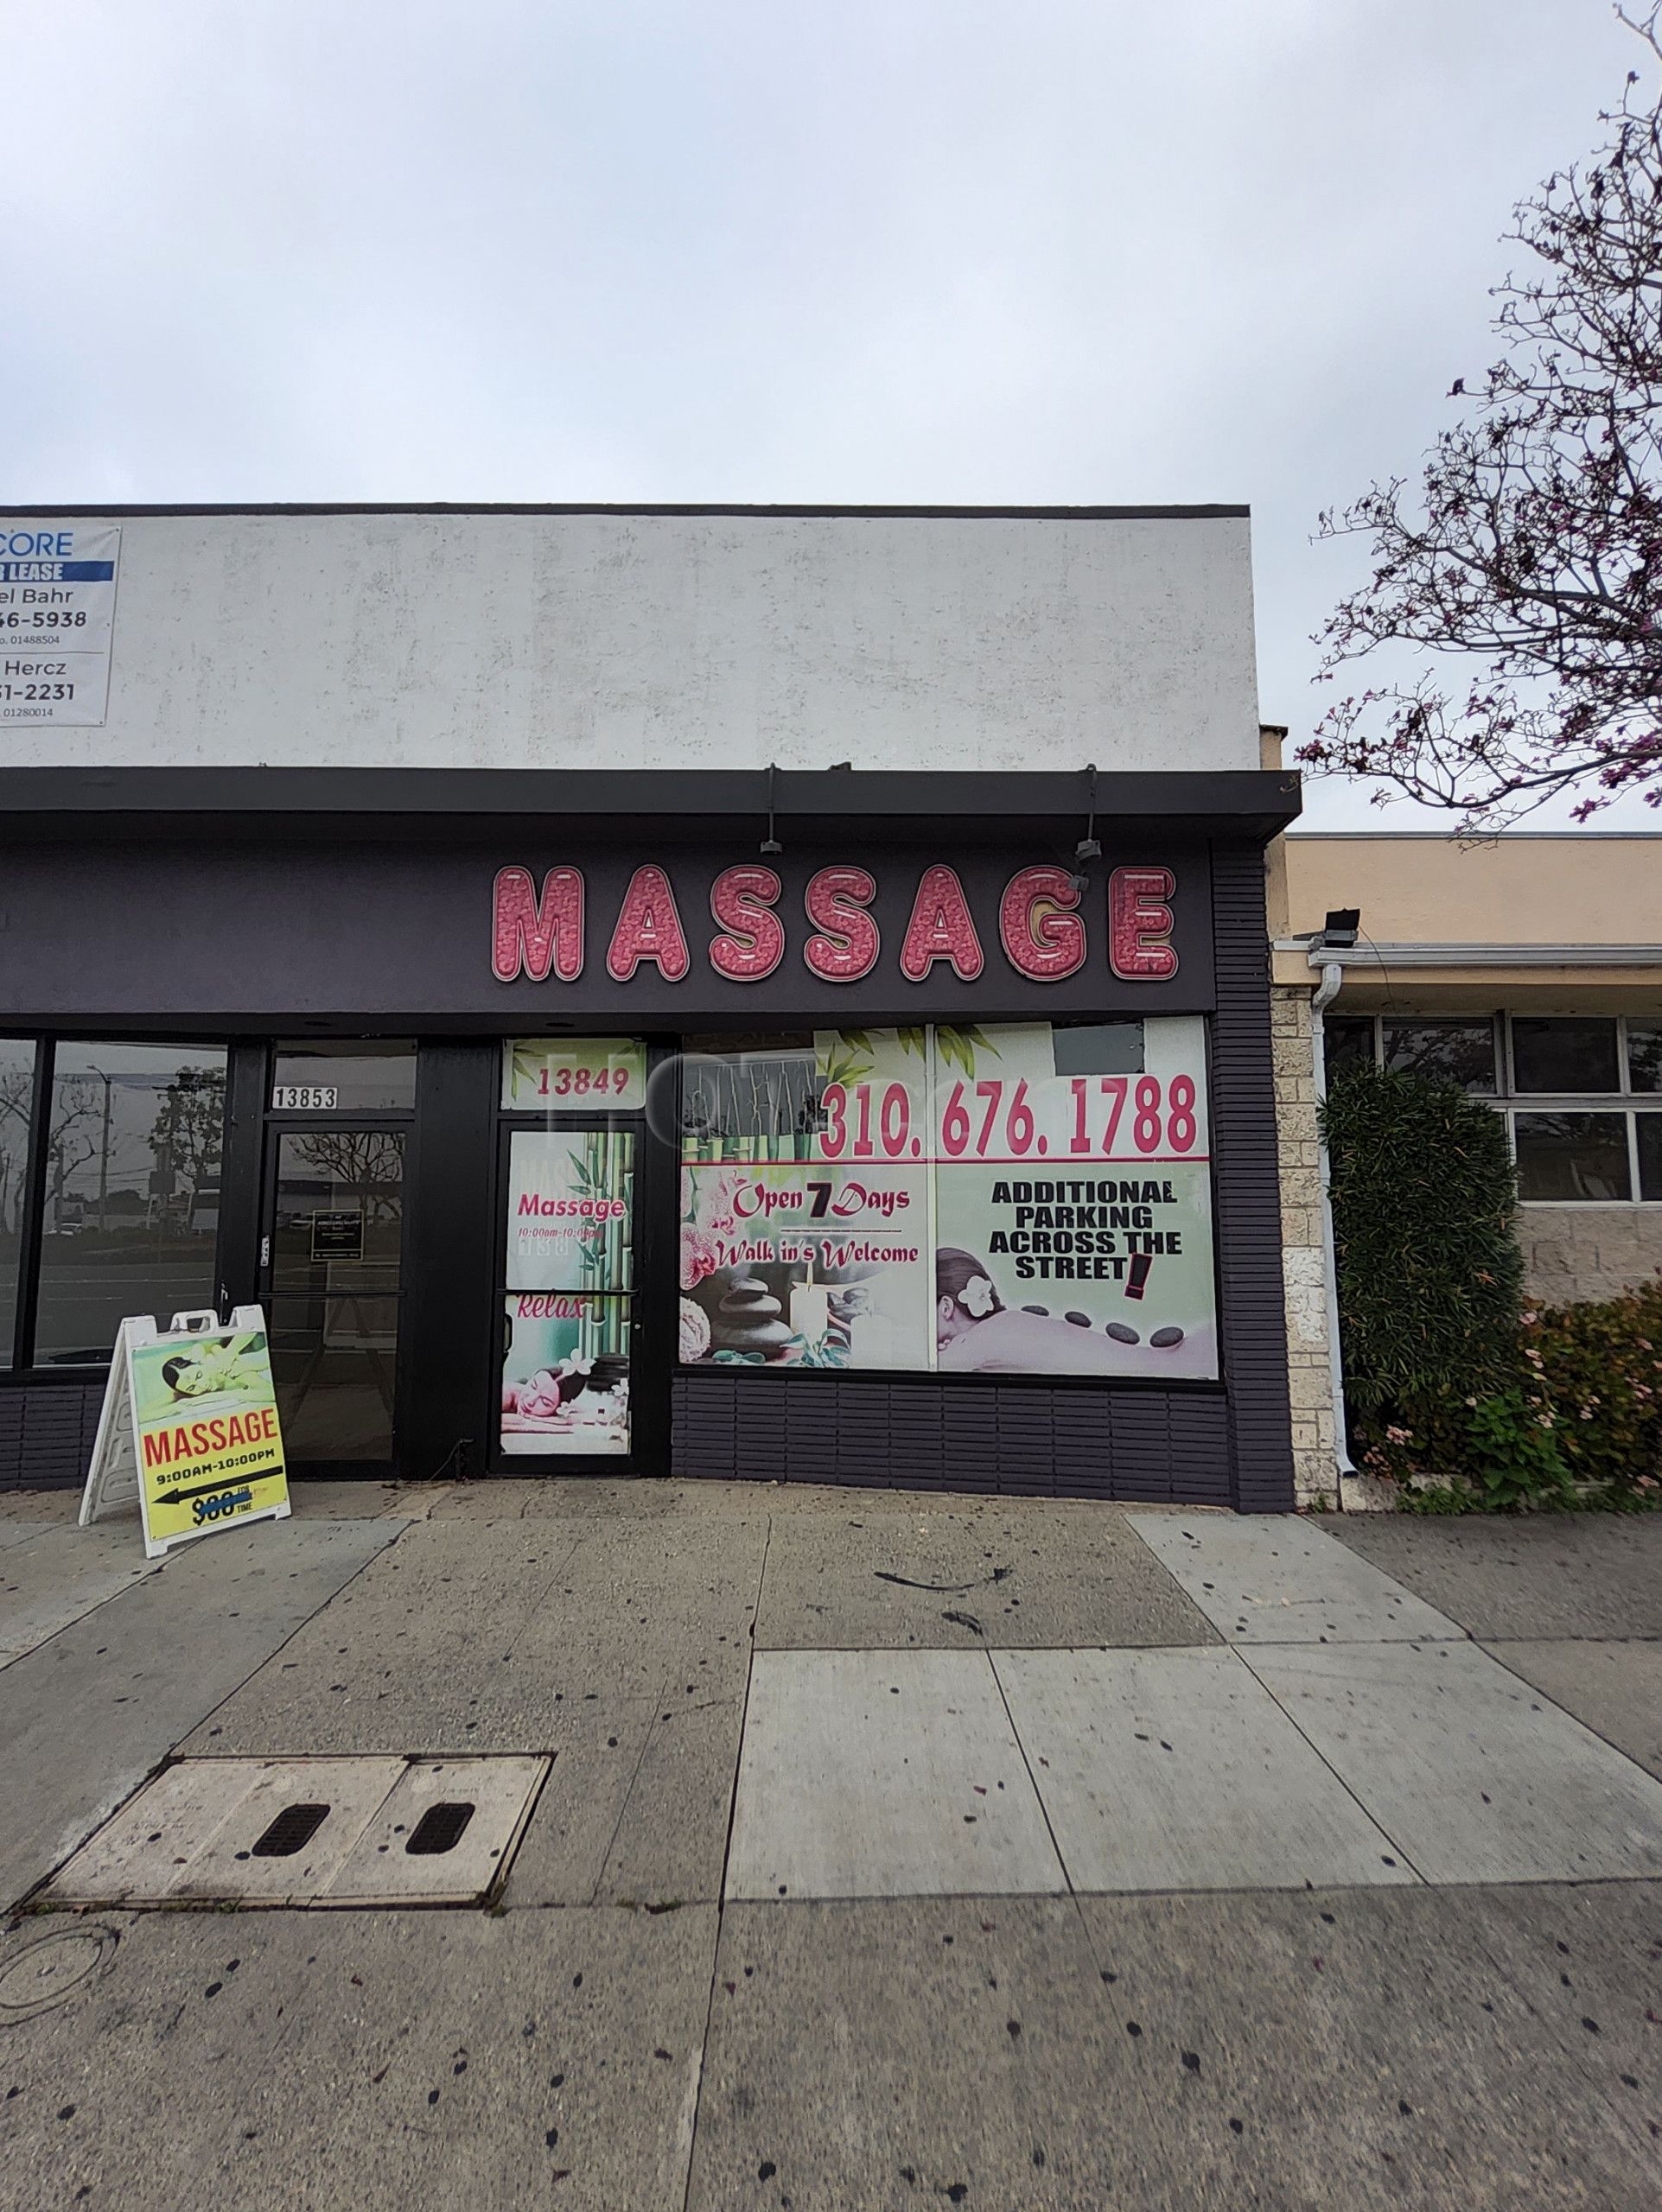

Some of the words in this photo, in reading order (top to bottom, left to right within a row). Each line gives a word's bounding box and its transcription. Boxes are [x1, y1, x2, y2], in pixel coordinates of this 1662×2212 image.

[10, 563, 64, 581] LEASE
[22, 588, 73, 603] Bahr
[10, 635, 60, 645] 01488504
[5, 660, 67, 676] Hercz
[0, 683, 74, 701] 1-2231
[3, 708, 54, 717] 01280014
[491, 865, 1178, 982] MASSAGE
[537, 1067, 629, 1096] 13849
[277, 1087, 335, 1108] 13853
[1070, 1073, 1198, 1154] 1788
[733, 1182, 803, 1218] Open
[806, 1182, 832, 1218] 7
[831, 1182, 911, 1217] Days
[991, 1180, 1178, 1204] ADDITIONAL
[517, 1193, 627, 1223] Massage
[1016, 1206, 1153, 1229] PARKING
[714, 1239, 774, 1267] Walk
[823, 1239, 919, 1268] Welcome
[988, 1230, 1116, 1254] ACROSS
[1124, 1231, 1183, 1255] THE
[516, 1293, 587, 1318] Relax
[143, 1408, 277, 1467] MASSAGE
[156, 1448, 275, 1485] 9:00AM-10:00PM
[237, 1502, 253, 1514] TIME
